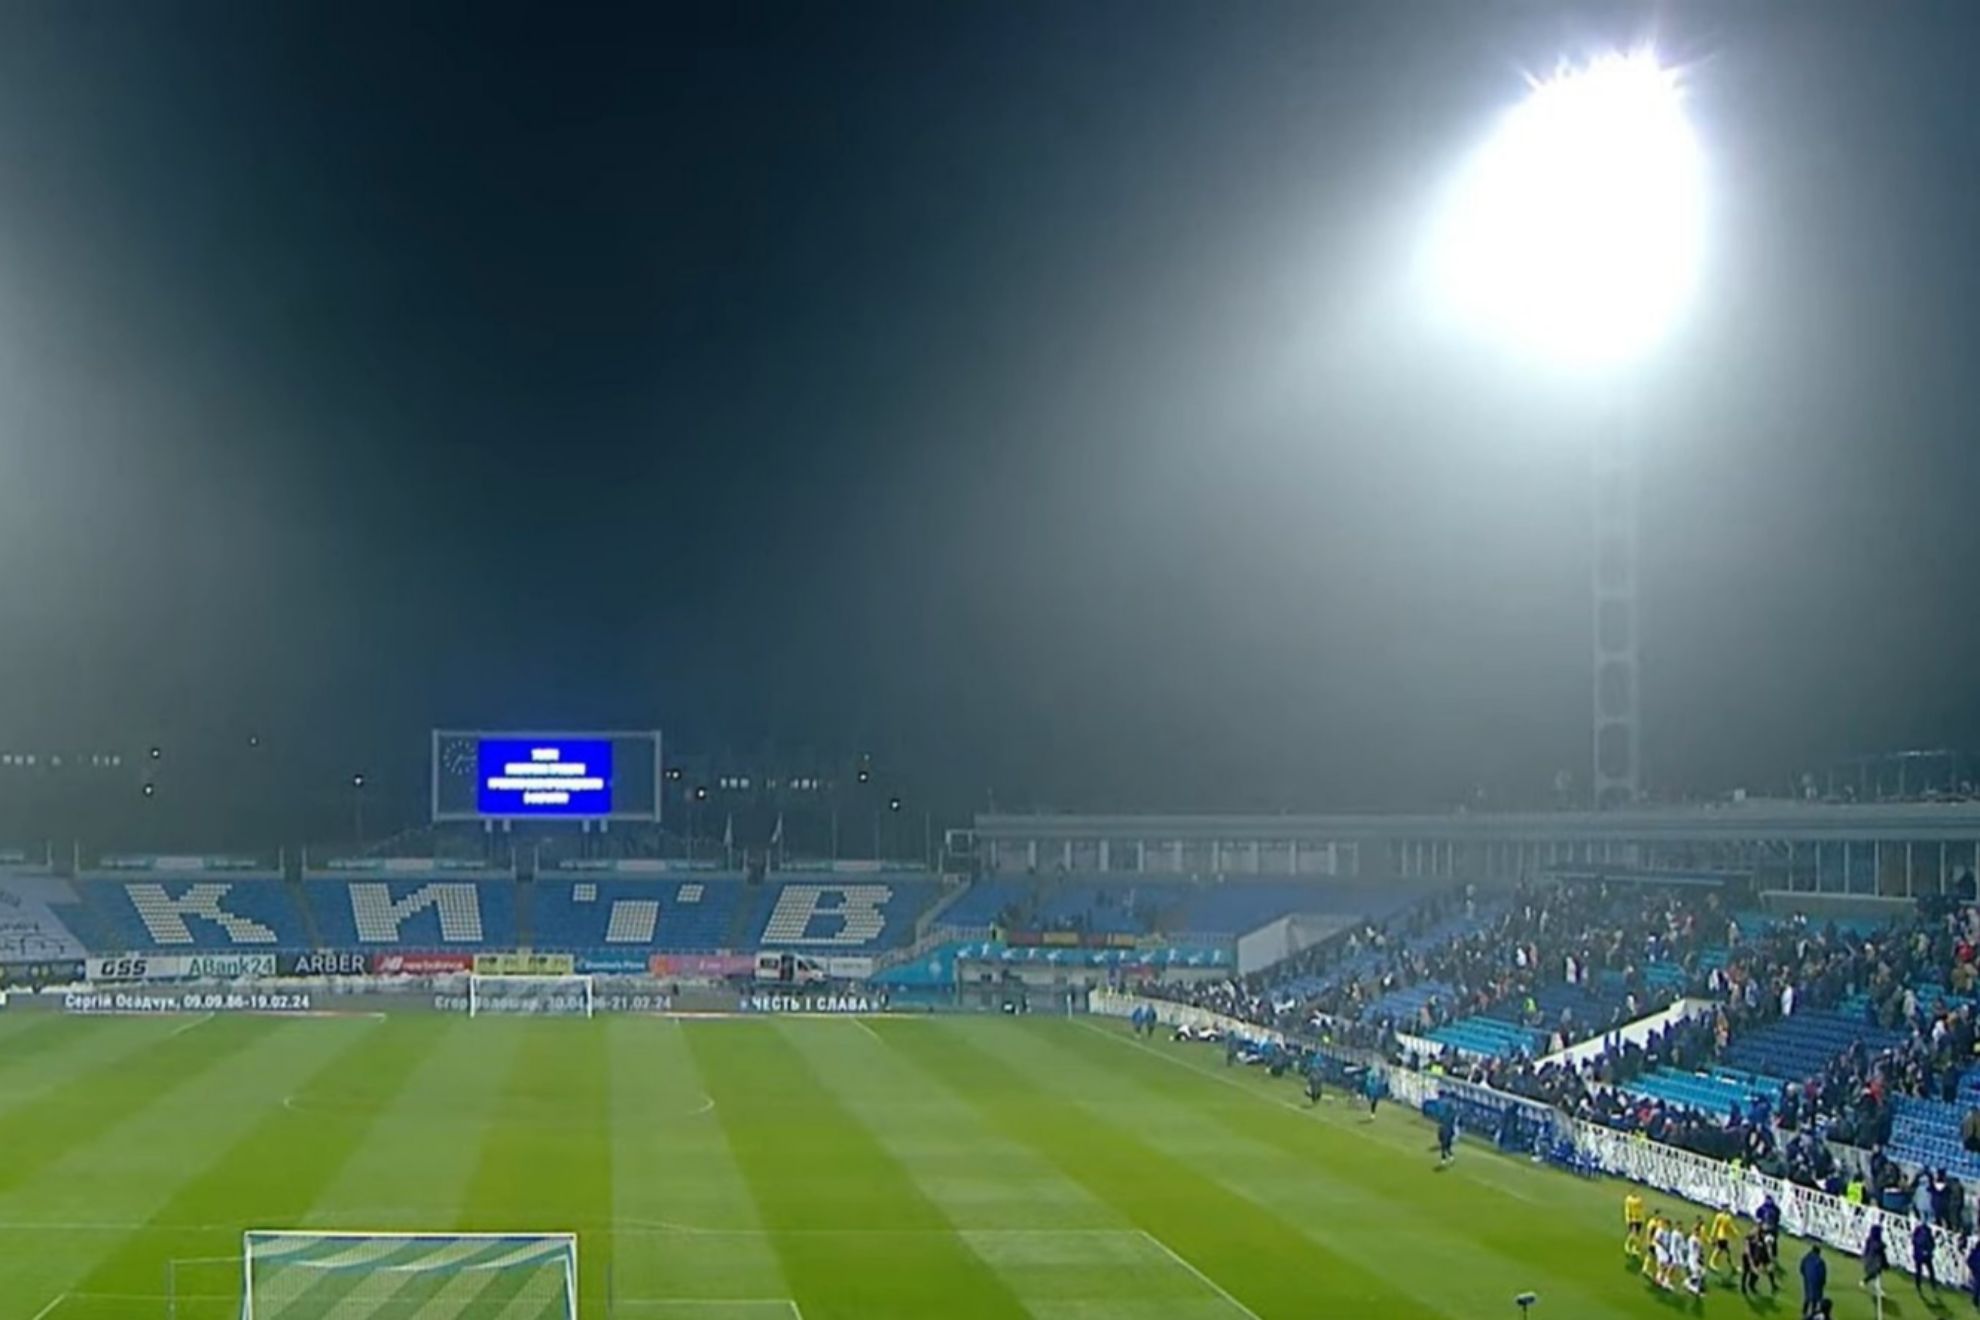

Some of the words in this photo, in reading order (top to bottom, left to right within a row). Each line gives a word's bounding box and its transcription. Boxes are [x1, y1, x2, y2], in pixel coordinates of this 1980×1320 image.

[189, 956, 274, 976] ABank24
[295, 954, 365, 973] ARBER
[751, 996, 800, 1011] ЧЕСТЬ
[816, 996, 869, 1011] СЛАВА
